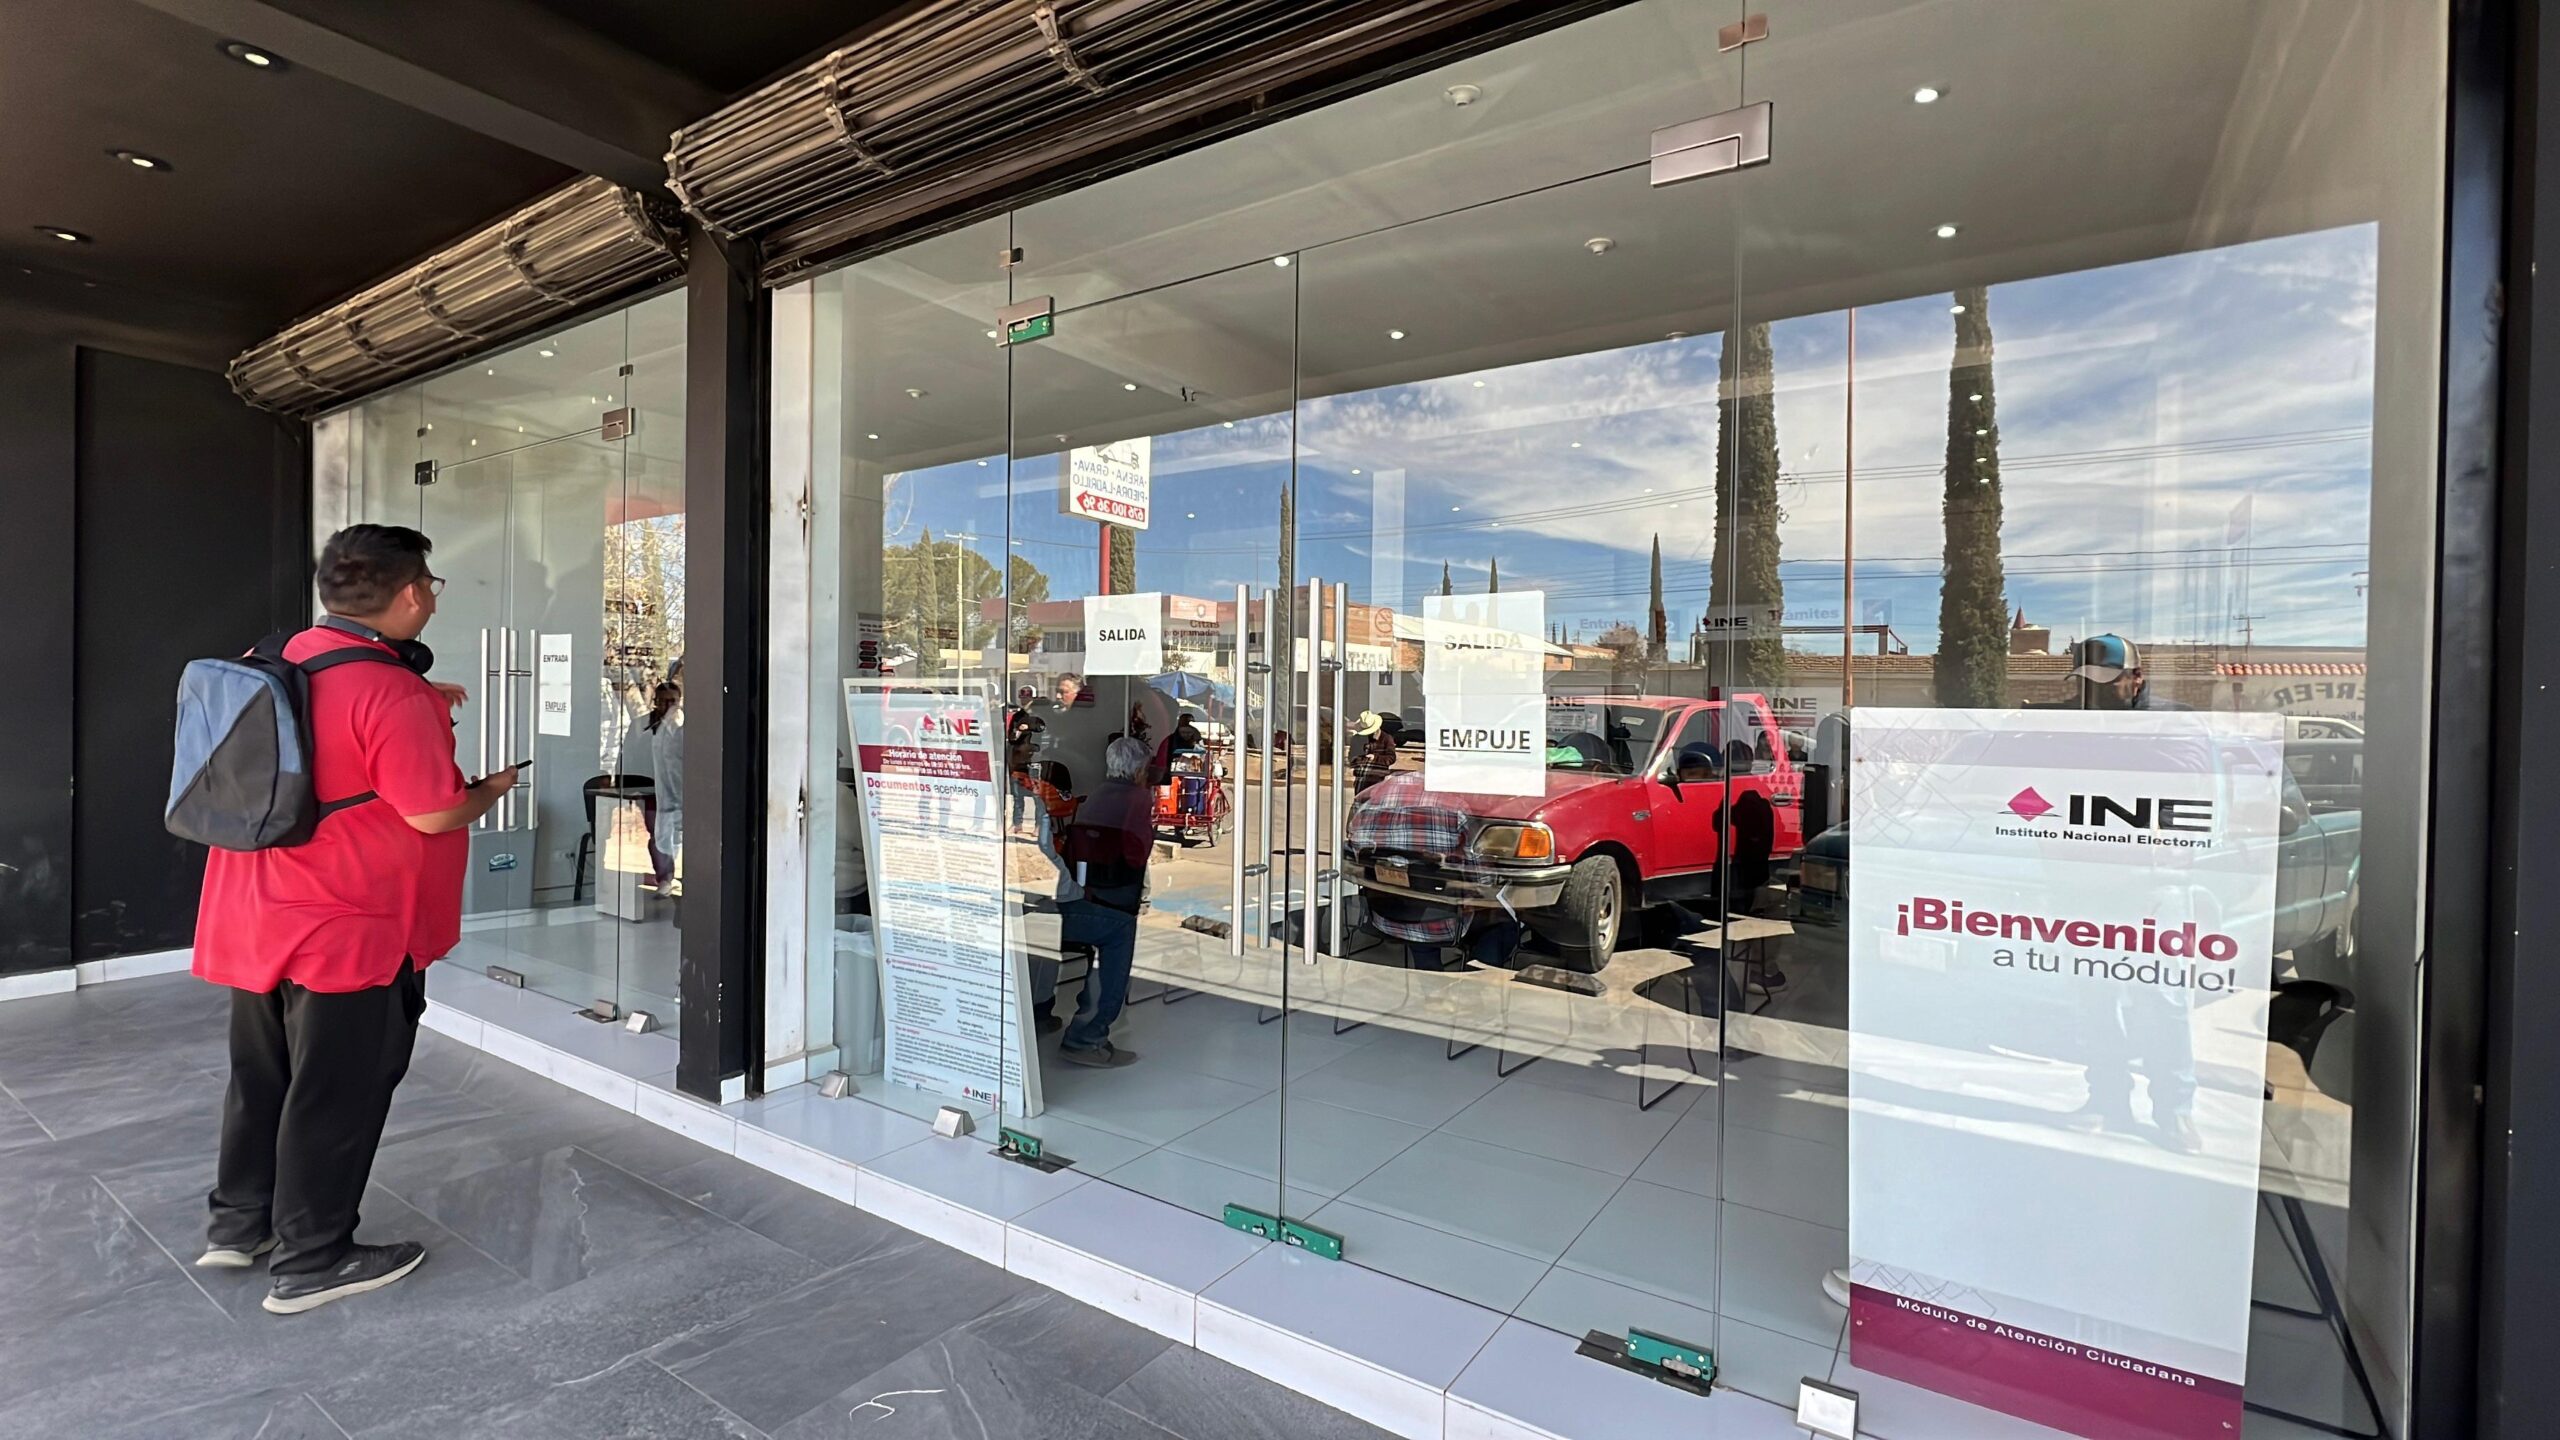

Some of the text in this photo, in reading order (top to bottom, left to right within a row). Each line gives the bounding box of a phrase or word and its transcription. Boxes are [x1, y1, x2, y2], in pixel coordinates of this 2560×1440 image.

[1099, 628, 1147, 642] SALIDA
[1444, 631, 1523, 651] SALIDA
[543, 654, 569, 663] ENTRADA
[545, 701, 567, 712] EMPUJE
[1773, 697, 1817, 709] INE
[939, 717, 981, 737] INE
[1439, 727, 1532, 751] EMPUJE
[867, 777, 932, 793] Documentos
[2069, 794, 2214, 832] INE
[1995, 826, 2212, 849] Instituto Nacional Electoral
[1896, 895, 2239, 962] ¡Bienvenido
[1992, 947, 2236, 994] a tu módulo!
[972, 1088, 993, 1103] INE
[1895, 1297, 2197, 1388] Módulo de Atención Ciudadana
